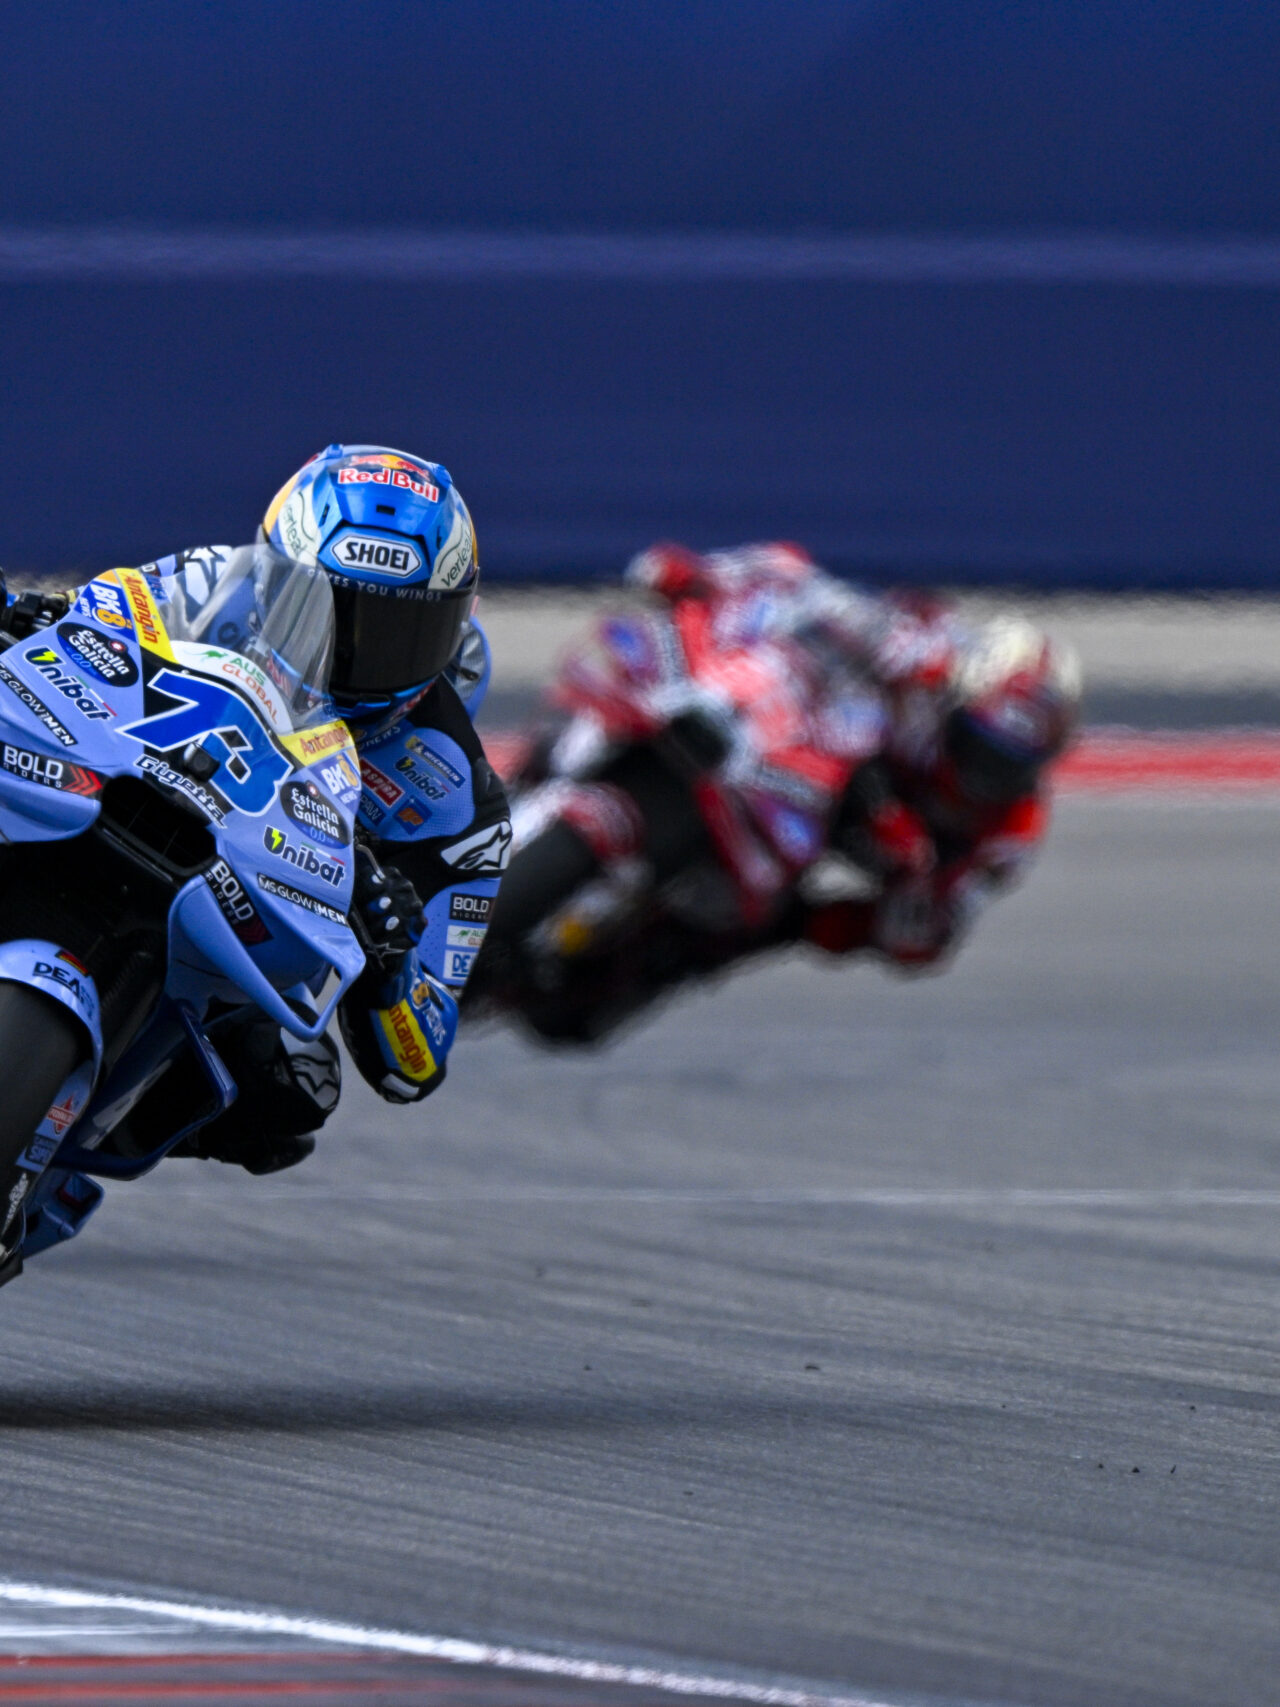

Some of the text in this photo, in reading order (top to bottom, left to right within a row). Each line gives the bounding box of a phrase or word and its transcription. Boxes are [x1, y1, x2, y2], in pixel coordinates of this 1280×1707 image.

[338, 468, 439, 503] Red Bull
[344, 541, 410, 571] SHOEI
[89, 583, 128, 629] BK8
[358, 581, 388, 596] YOU
[396, 588, 442, 602] WINGS
[69, 634, 116, 678] Galicia
[78, 630, 130, 674] Estrella
[230, 656, 266, 687] AUS
[24, 646, 112, 721] Unibat
[222, 663, 278, 724] GLOBAL
[8, 680, 45, 712] GLOW
[44, 716, 74, 745] MEN
[4, 745, 63, 780] BOLD
[114, 667, 294, 817] 73
[4, 762, 63, 788] RIDERS
[133, 754, 227, 829] Gigetta
[321, 755, 359, 795] BK8
[395, 756, 447, 800] Unibat
[291, 788, 339, 824] Estrella
[293, 804, 340, 838] Galicia
[263, 824, 346, 888] Unibat
[210, 860, 254, 921] BOLD
[278, 885, 312, 909] GLOW
[317, 904, 347, 925] MEN
[453, 896, 489, 913] BOLD
[34, 962, 80, 999] DEA
[388, 1005, 427, 1074] ntangin
